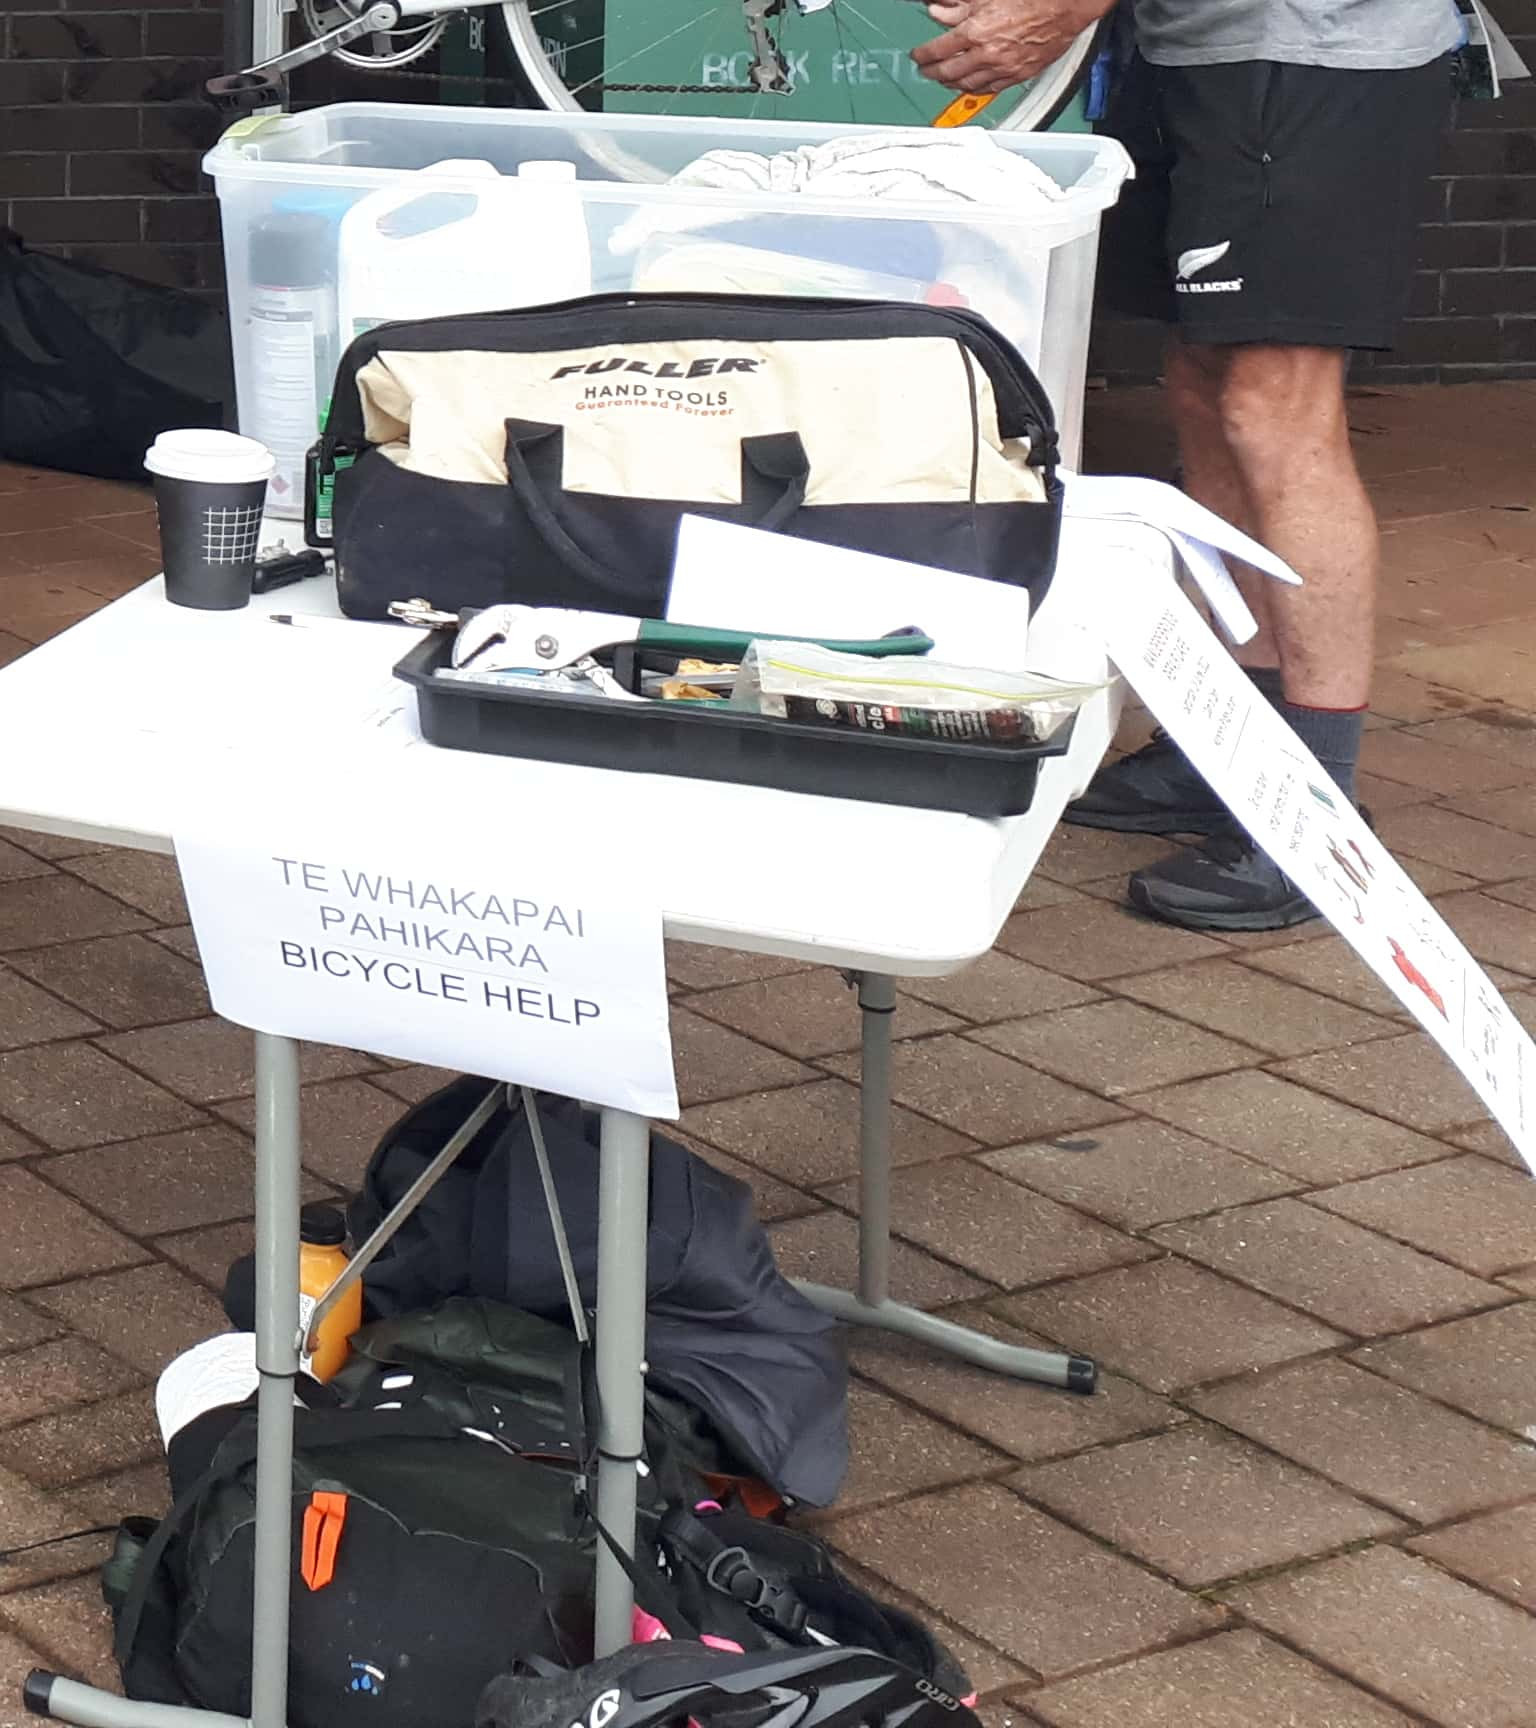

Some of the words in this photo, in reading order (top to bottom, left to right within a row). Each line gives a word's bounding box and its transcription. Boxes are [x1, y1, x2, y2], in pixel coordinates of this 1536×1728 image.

[701, 48, 810, 87] BOK
[1189, 280, 1242, 293] BLACKS
[550, 357, 760, 380] FULLER
[575, 399, 669, 411] Guaranteed
[675, 403, 736, 417] Forever
[584, 384, 648, 400] HAND
[655, 387, 728, 406] TOOLS
[271, 856, 329, 893] TE
[341, 868, 585, 938] WHAKAPAI
[319, 905, 549, 973] PAHIKARA
[280, 940, 468, 1003] BICYCLE
[484, 981, 602, 1026] HELP
